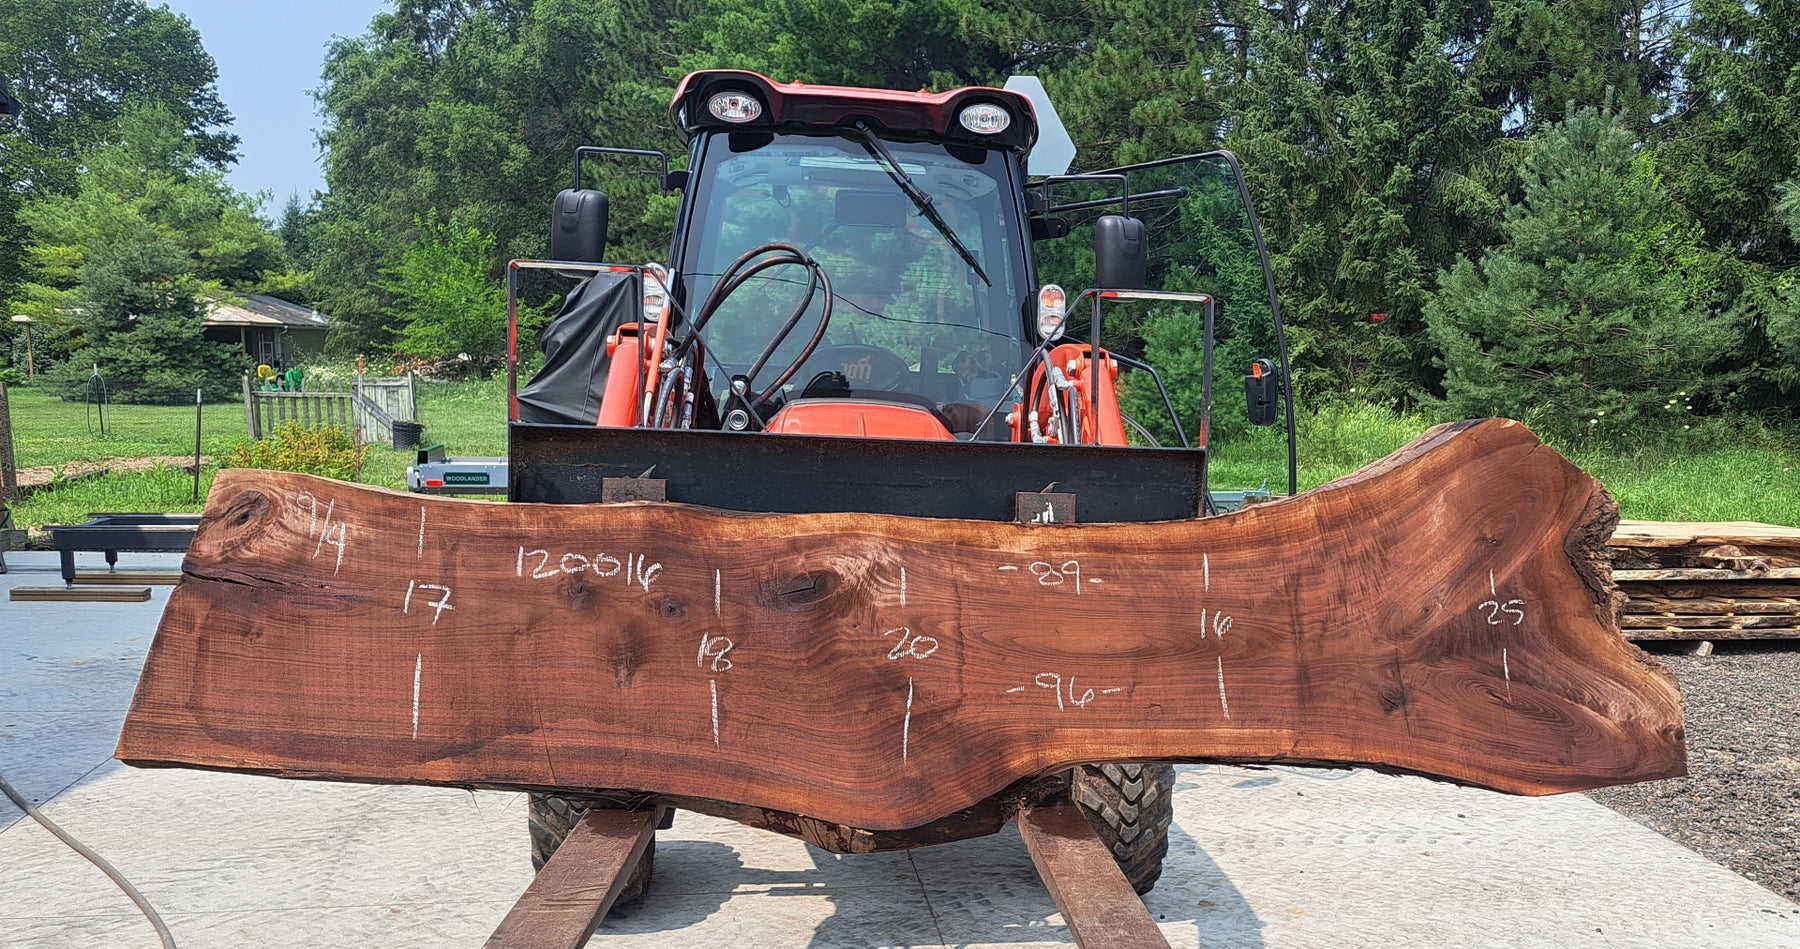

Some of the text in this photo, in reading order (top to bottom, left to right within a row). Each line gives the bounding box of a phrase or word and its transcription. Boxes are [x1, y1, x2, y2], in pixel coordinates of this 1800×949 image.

[446, 474, 488, 483] WOODLANDER
[296, 490, 346, 577] 9/4
[515, 545, 663, 592] 120016
[403, 579, 455, 626] 17
[1478, 599, 1526, 626] 25
[1200, 607, 1233, 640] 16
[697, 631, 733, 672] 18
[883, 627, 938, 660] 20
